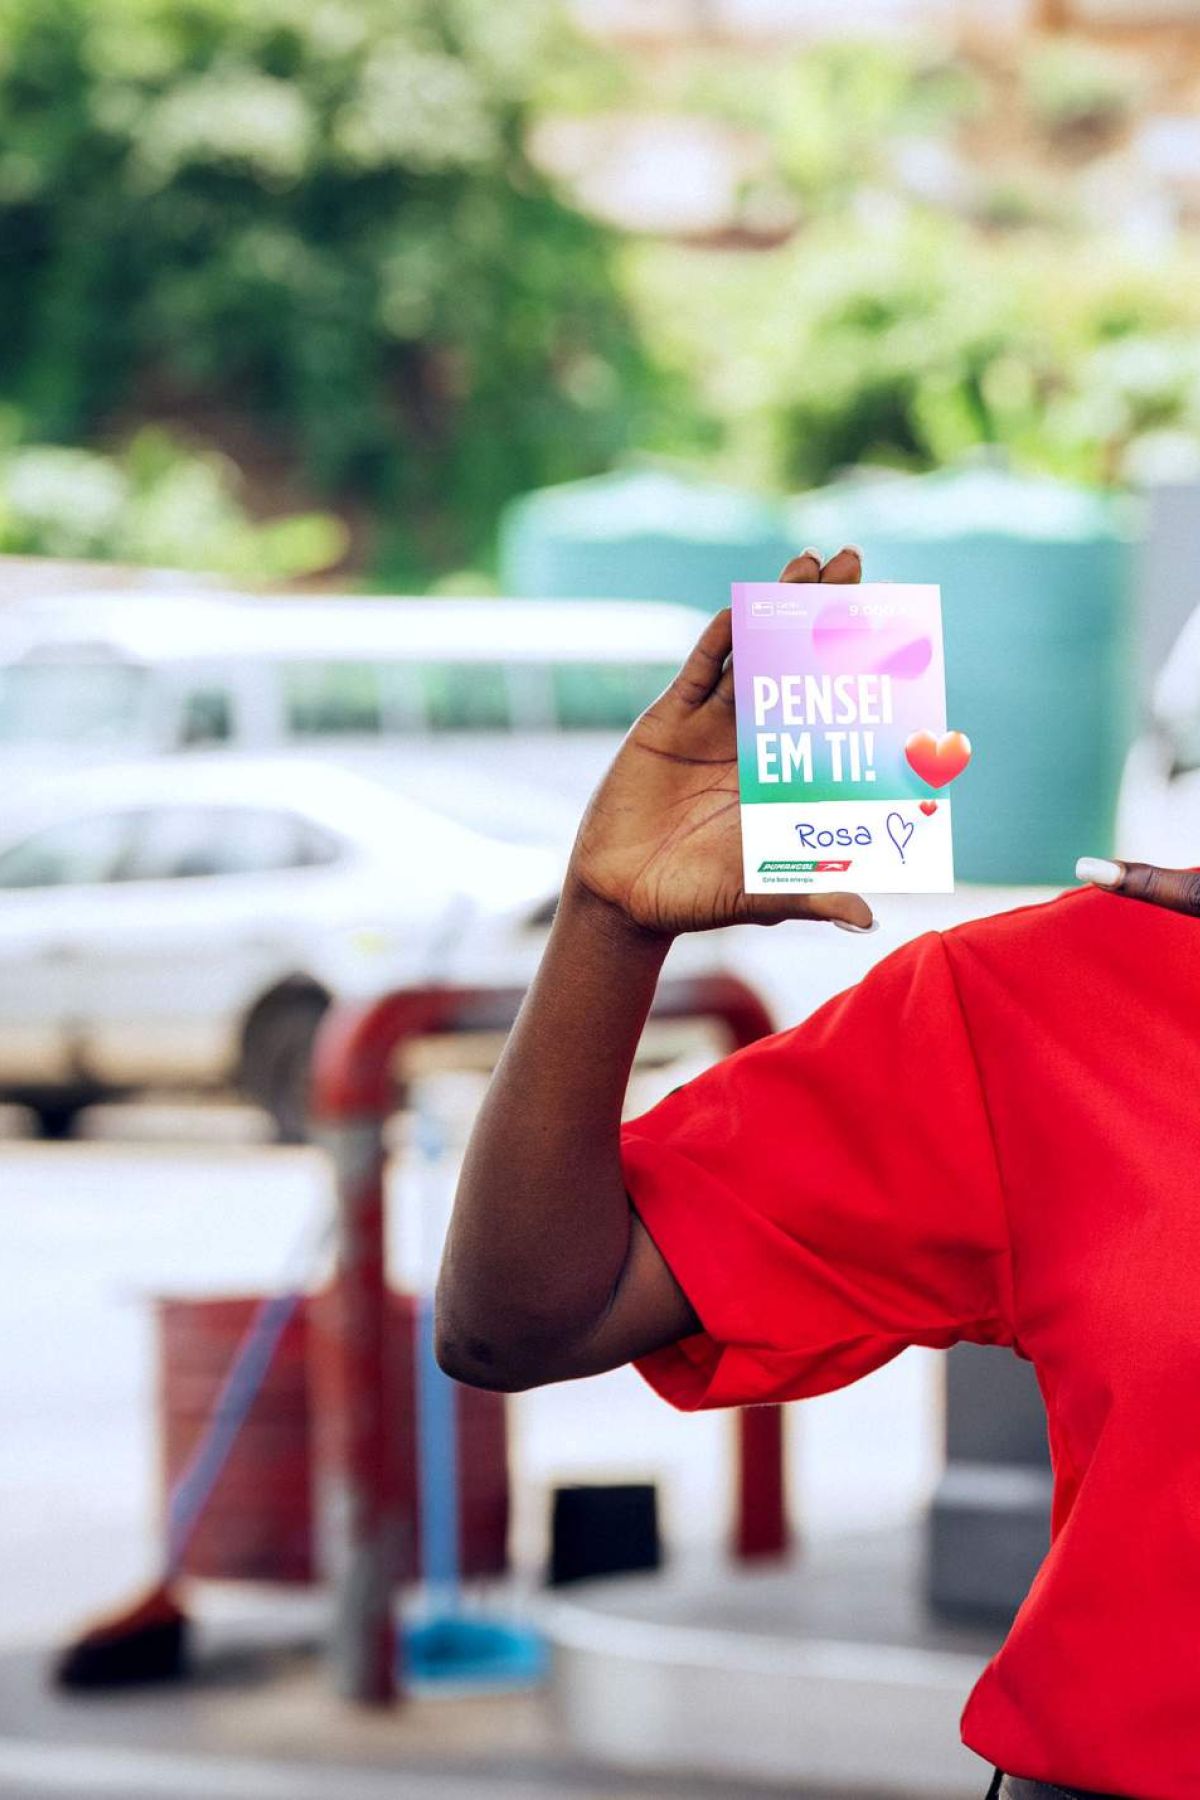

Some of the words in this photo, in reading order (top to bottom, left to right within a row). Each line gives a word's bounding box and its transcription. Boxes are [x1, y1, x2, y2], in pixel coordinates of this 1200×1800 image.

[753, 674, 893, 726] PENSEI
[756, 732, 814, 784] EM
[825, 731, 877, 783] TI!
[795, 823, 873, 849] Rosa
